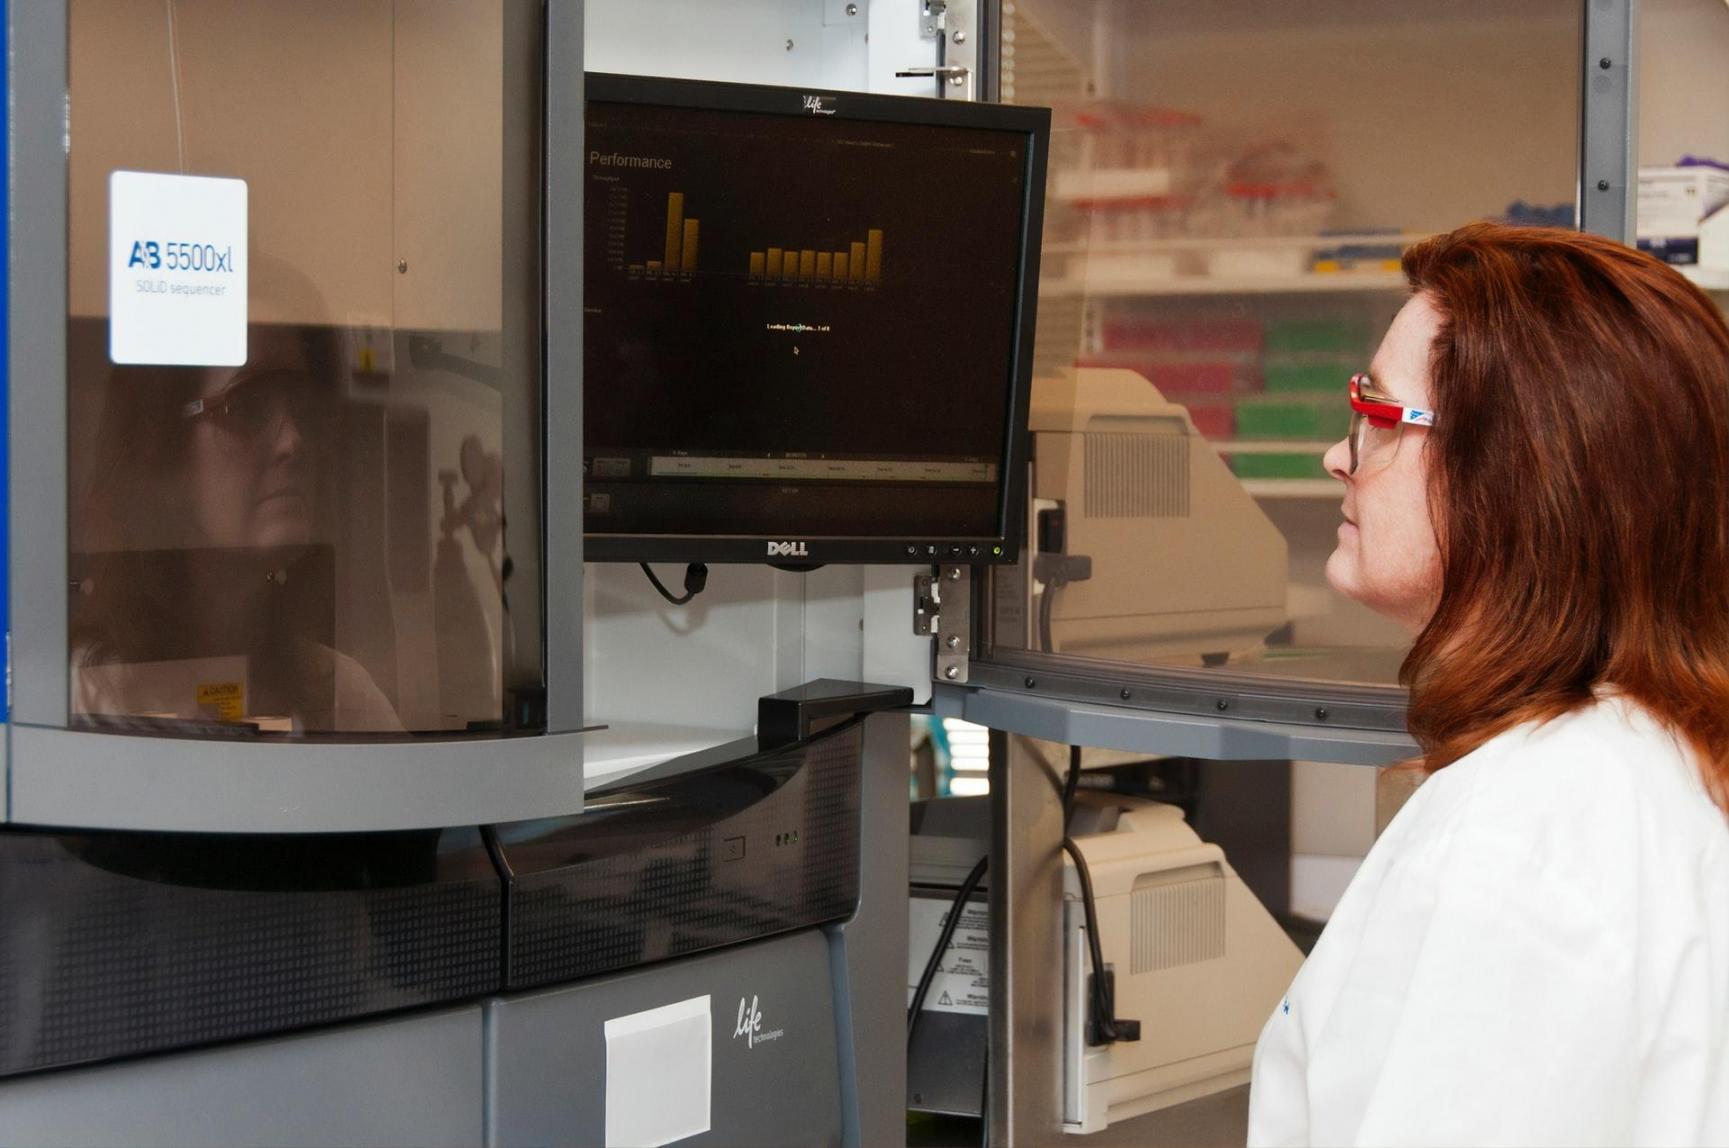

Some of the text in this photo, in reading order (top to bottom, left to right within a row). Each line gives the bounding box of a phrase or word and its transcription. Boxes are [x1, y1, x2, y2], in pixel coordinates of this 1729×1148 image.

[804, 96, 822, 114] life
[589, 151, 673, 170] Performance
[166, 242, 233, 273] 5500xl
[170, 283, 227, 298] sequencer
[767, 541, 809, 556] DELL
[733, 994, 762, 1049] life
